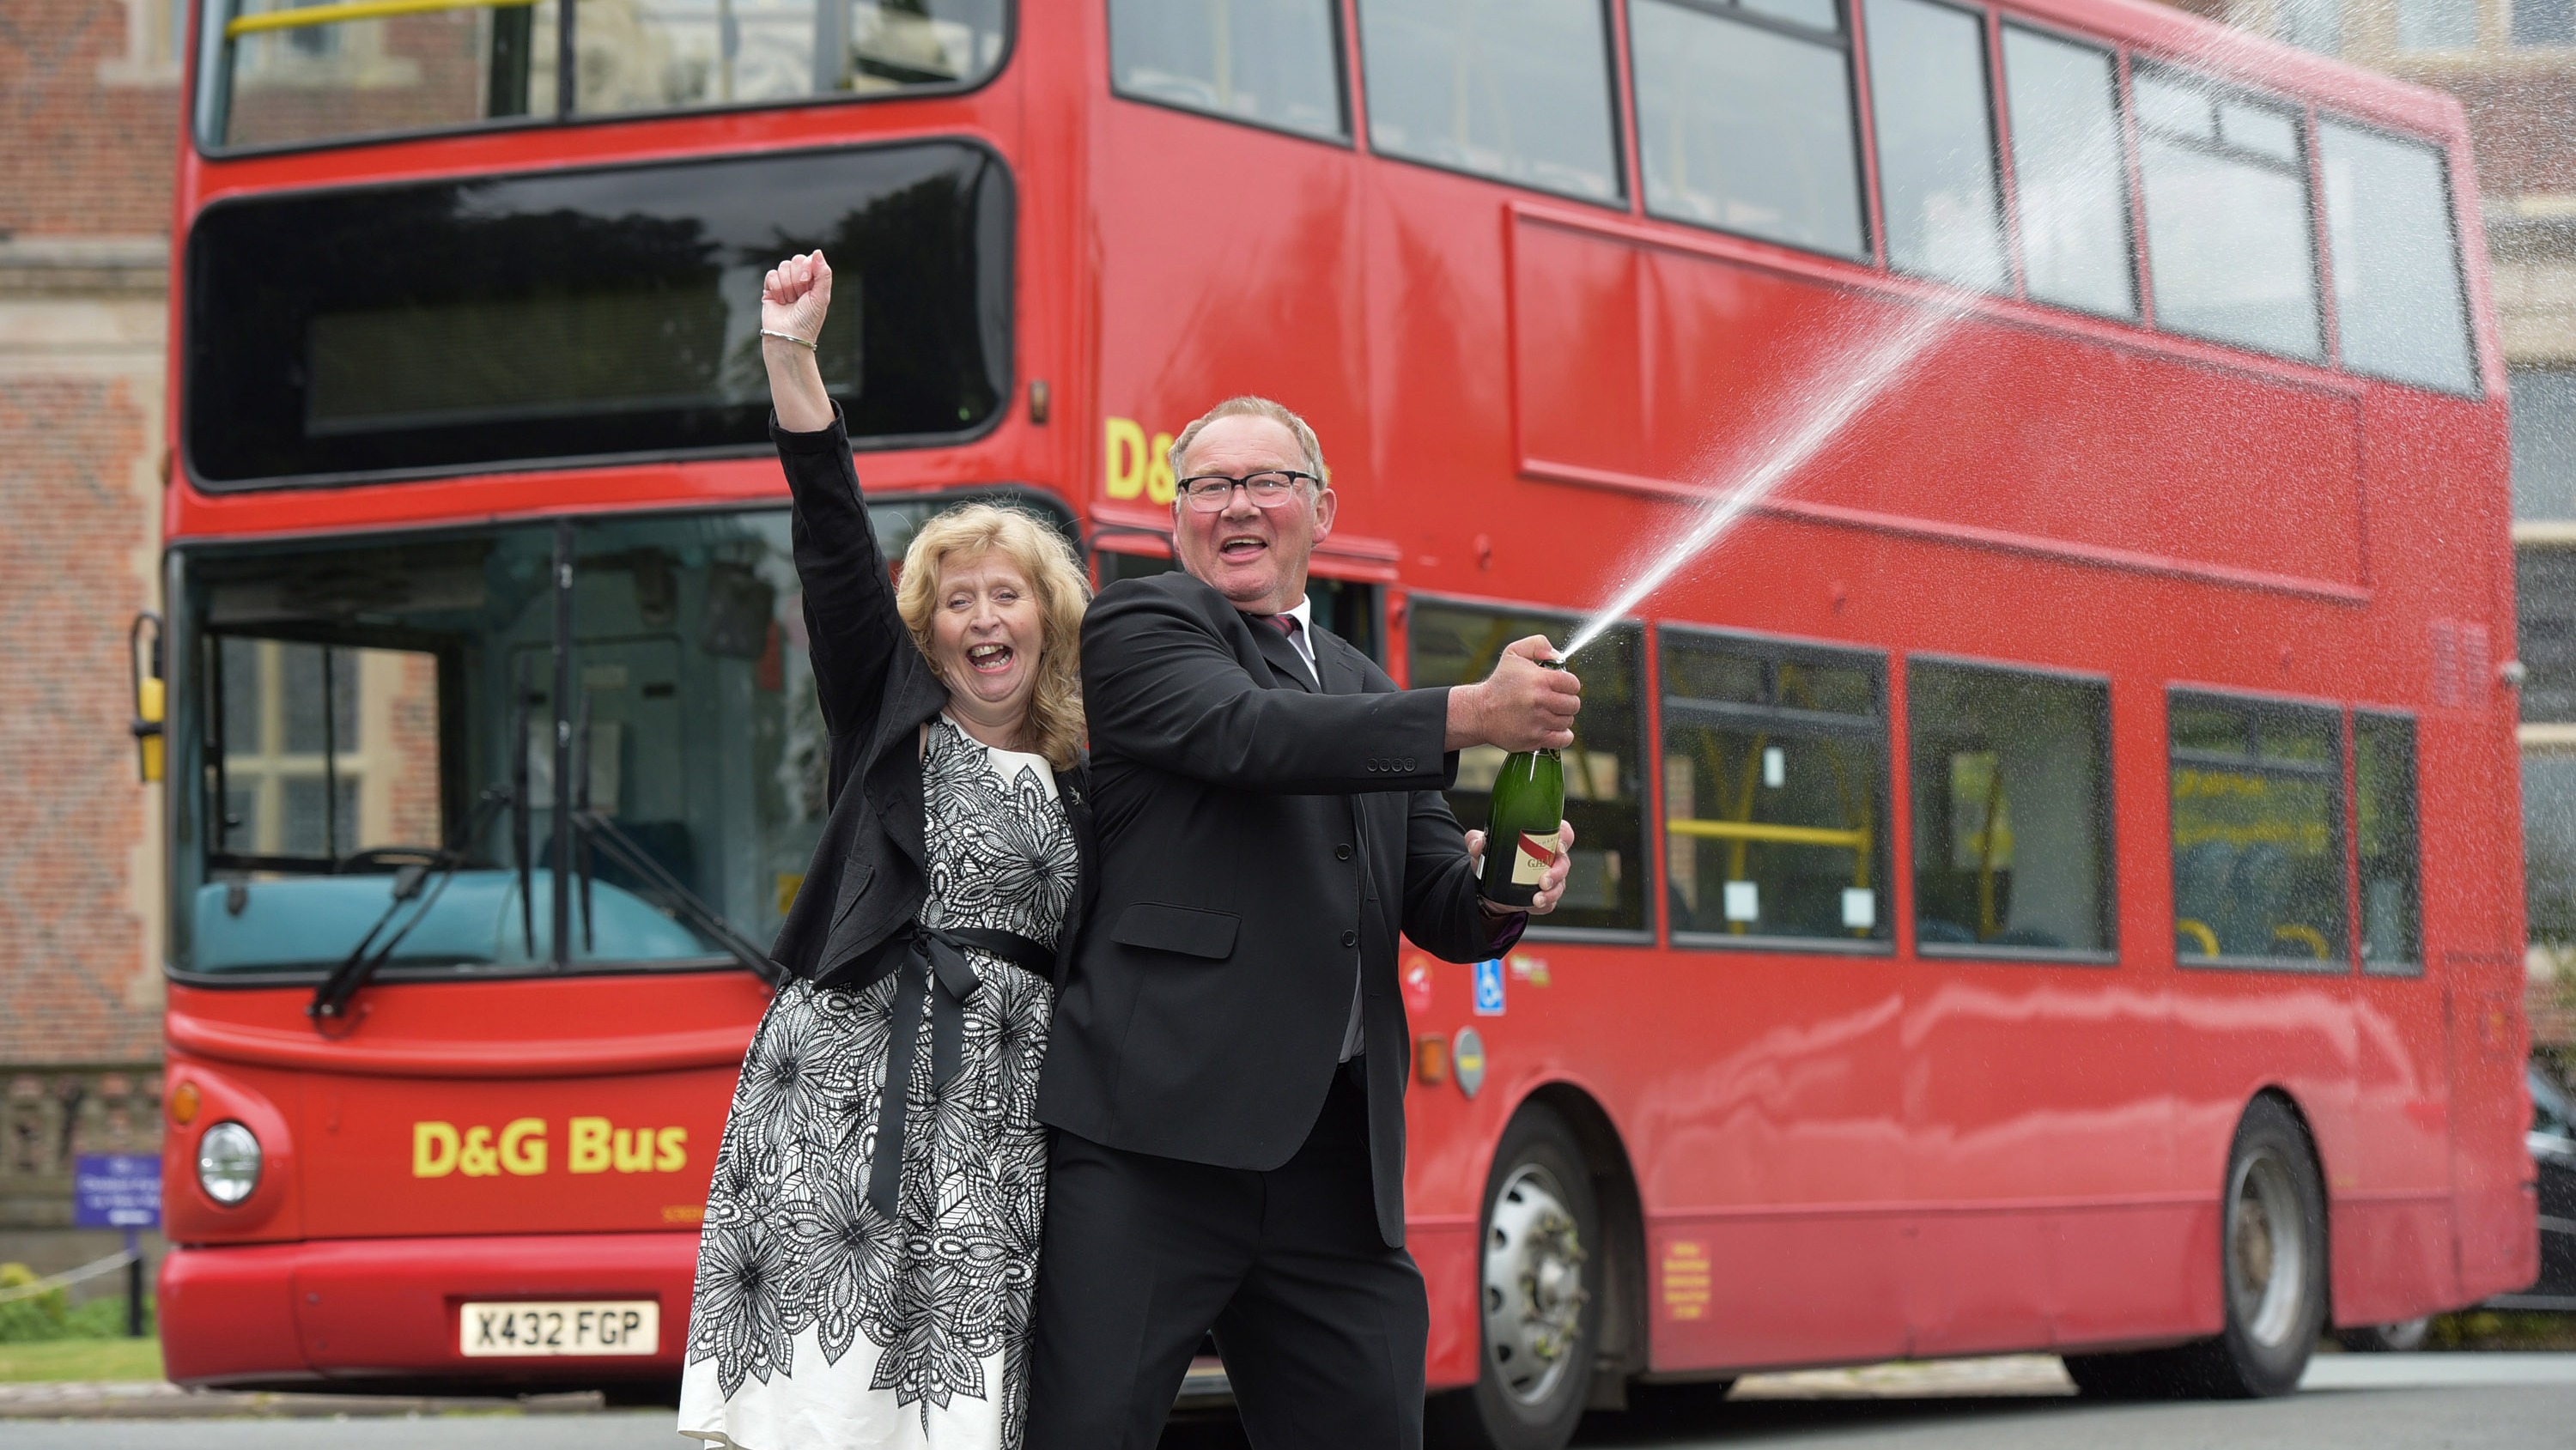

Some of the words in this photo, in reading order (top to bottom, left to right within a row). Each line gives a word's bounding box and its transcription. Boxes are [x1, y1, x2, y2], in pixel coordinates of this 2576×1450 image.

[1105, 416, 1176, 506] D&
[412, 1118, 548, 1177] D&G
[568, 1116, 687, 1174] Bus
[477, 1312, 563, 1346] X432
[576, 1311, 641, 1344] FGP
